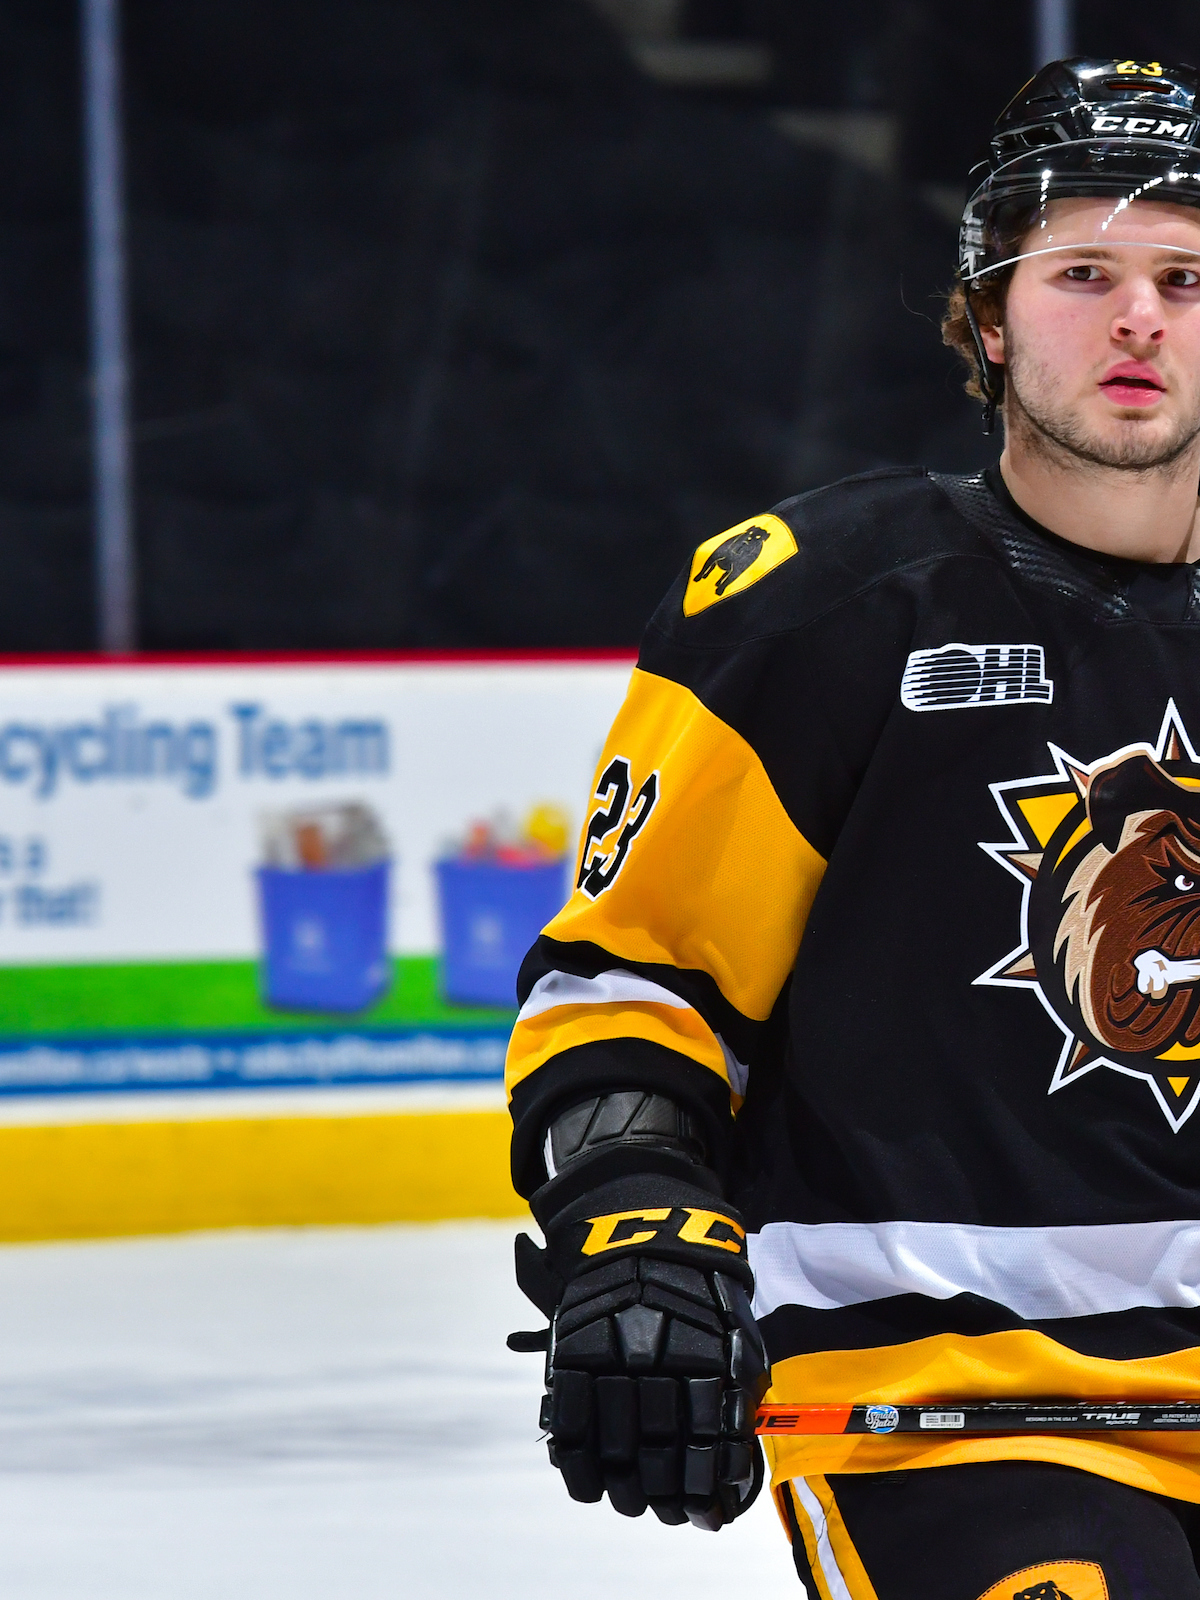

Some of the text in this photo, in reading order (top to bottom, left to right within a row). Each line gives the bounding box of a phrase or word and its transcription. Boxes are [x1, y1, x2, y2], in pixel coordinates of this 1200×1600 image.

[1091, 115, 1189, 137] CCM
[901, 643, 1053, 712] OHL
[229, 702, 392, 778] Team
[576, 754, 661, 902] 23
[865, 1411, 896, 1424] Small
[869, 1420, 897, 1430] Batch
